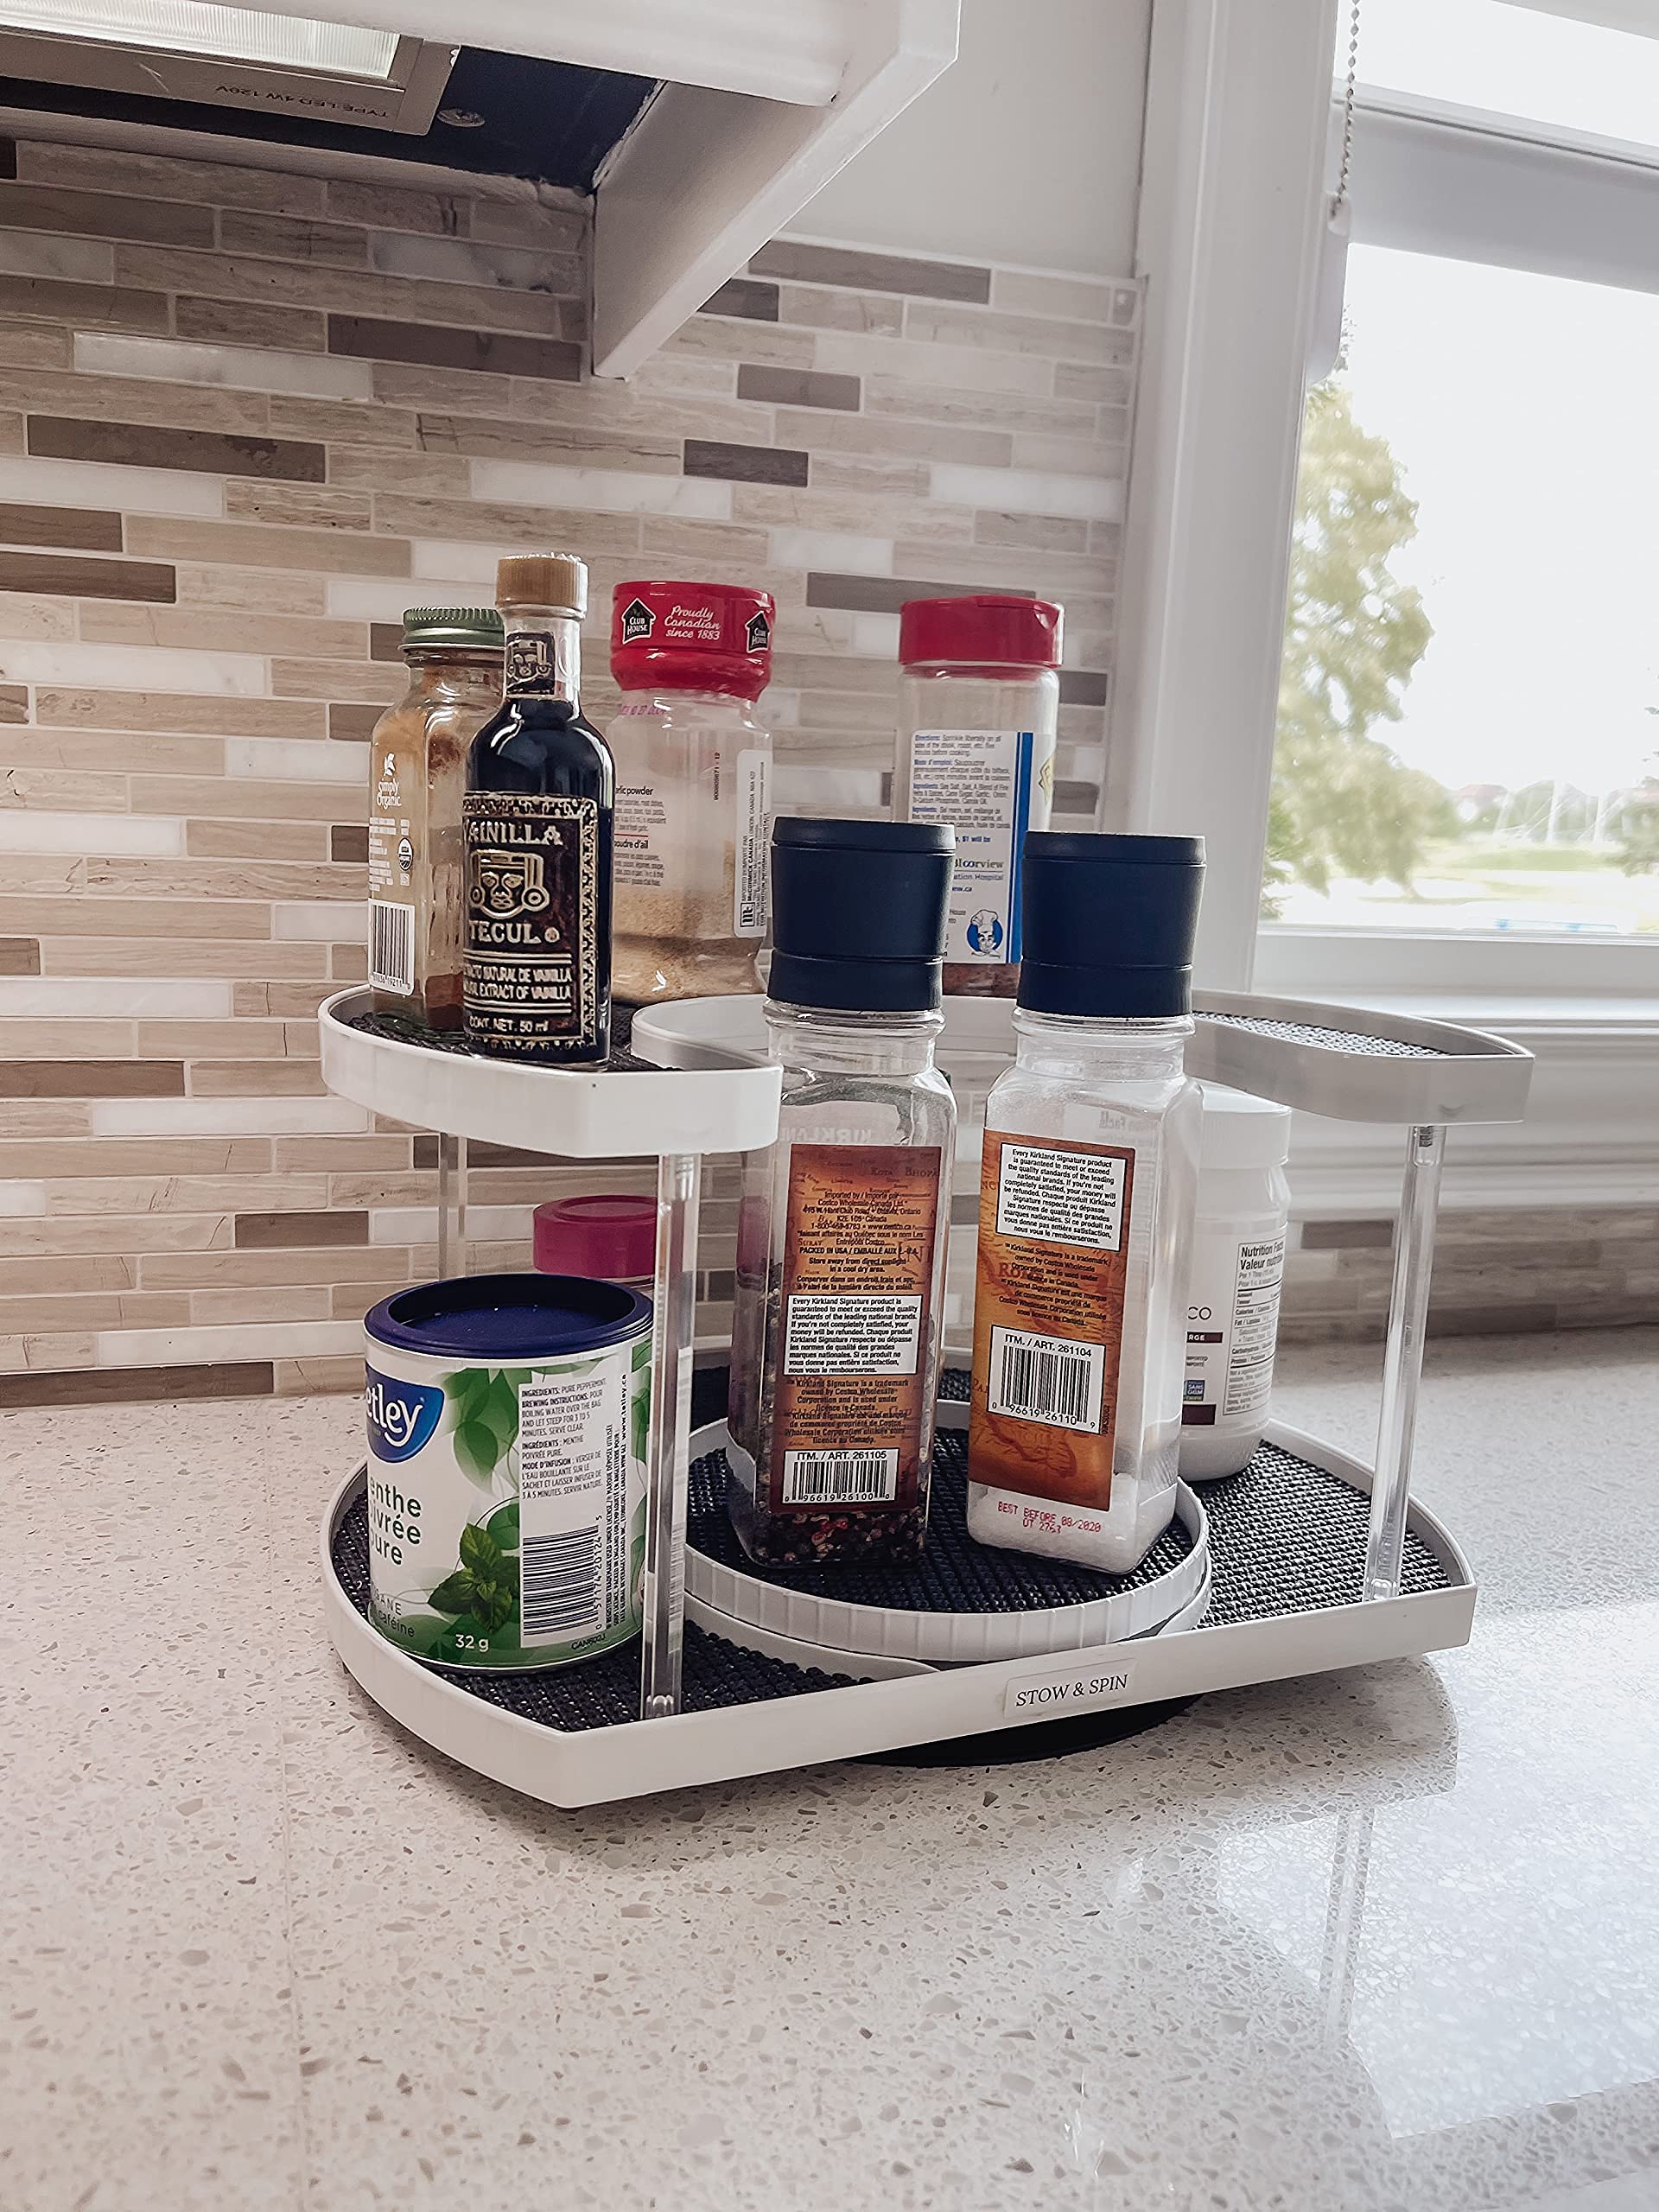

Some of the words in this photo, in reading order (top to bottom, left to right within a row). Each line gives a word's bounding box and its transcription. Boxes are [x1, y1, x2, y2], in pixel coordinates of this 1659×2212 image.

[216, 86, 257, 96] 120V
[300, 99, 335, 108] LED
[343, 106, 387, 117] TYPE
[671, 606, 714, 620] Proudly
[664, 616, 721, 629] Canadian
[627, 625, 647, 634] HOUSE
[697, 630, 720, 639] 1883
[627, 786, 653, 796] powder
[468, 821, 563, 845] AINILLA
[518, 969, 531, 982] DE
[480, 983, 514, 999] EXTRACT
[516, 986, 529, 1000] OF
[519, 1020, 532, 1032] 50
[1013, 1149, 1028, 1159] Every
[1030, 1152, 1055, 1161] Kirkland
[1057, 1155, 1086, 1165] Signature
[1088, 1160, 1112, 1168] product
[1020, 1158, 1053, 1168] guaranteed
[1020, 1165, 1039, 1174] quality
[1040, 1168, 1071, 1178] standards
[1091, 1175, 1115, 1185] leading
[1005, 1179, 1037, 1190] completely
[1039, 1184, 1065, 1193] satisfied,
[1082, 1190, 1103, 1199] money
[1043, 1176, 1065, 1185] brands.
[1072, 1180, 1091, 1189] you're
[1242, 1245, 1273, 1257] Nutrition
[1241, 1259, 1265, 1270] Valeur
[1005, 1334, 1025, 1345] ITM.
[1033, 1339, 1055, 1351] ART.
[1058, 1344, 1091, 1357] 261104
[522, 1398, 549, 1408] BREWING
[546, 1405, 564, 1414] WATER
[567, 1404, 580, 1413] OVER
[365, 1383, 423, 1447] etley
[546, 1416, 562, 1425] STEEP
[1009, 1404, 1040, 1418] 96619
[1046, 1411, 1077, 1425] 26110
[829, 1452, 850, 1460] ART.
[853, 1451, 887, 1459] 261105
[370, 1477, 421, 1517] enthe
[998, 1501, 1018, 1515] BEST
[1024, 1507, 1056, 1524] BEFORE
[370, 1500, 421, 1544] ivrée
[455, 1634, 474, 1649] 32
[479, 1638, 488, 1653] g
[1015, 1685, 1070, 1707] STOW
[1072, 1682, 1084, 1696] &
[1090, 1675, 1128, 1694] SPIN
